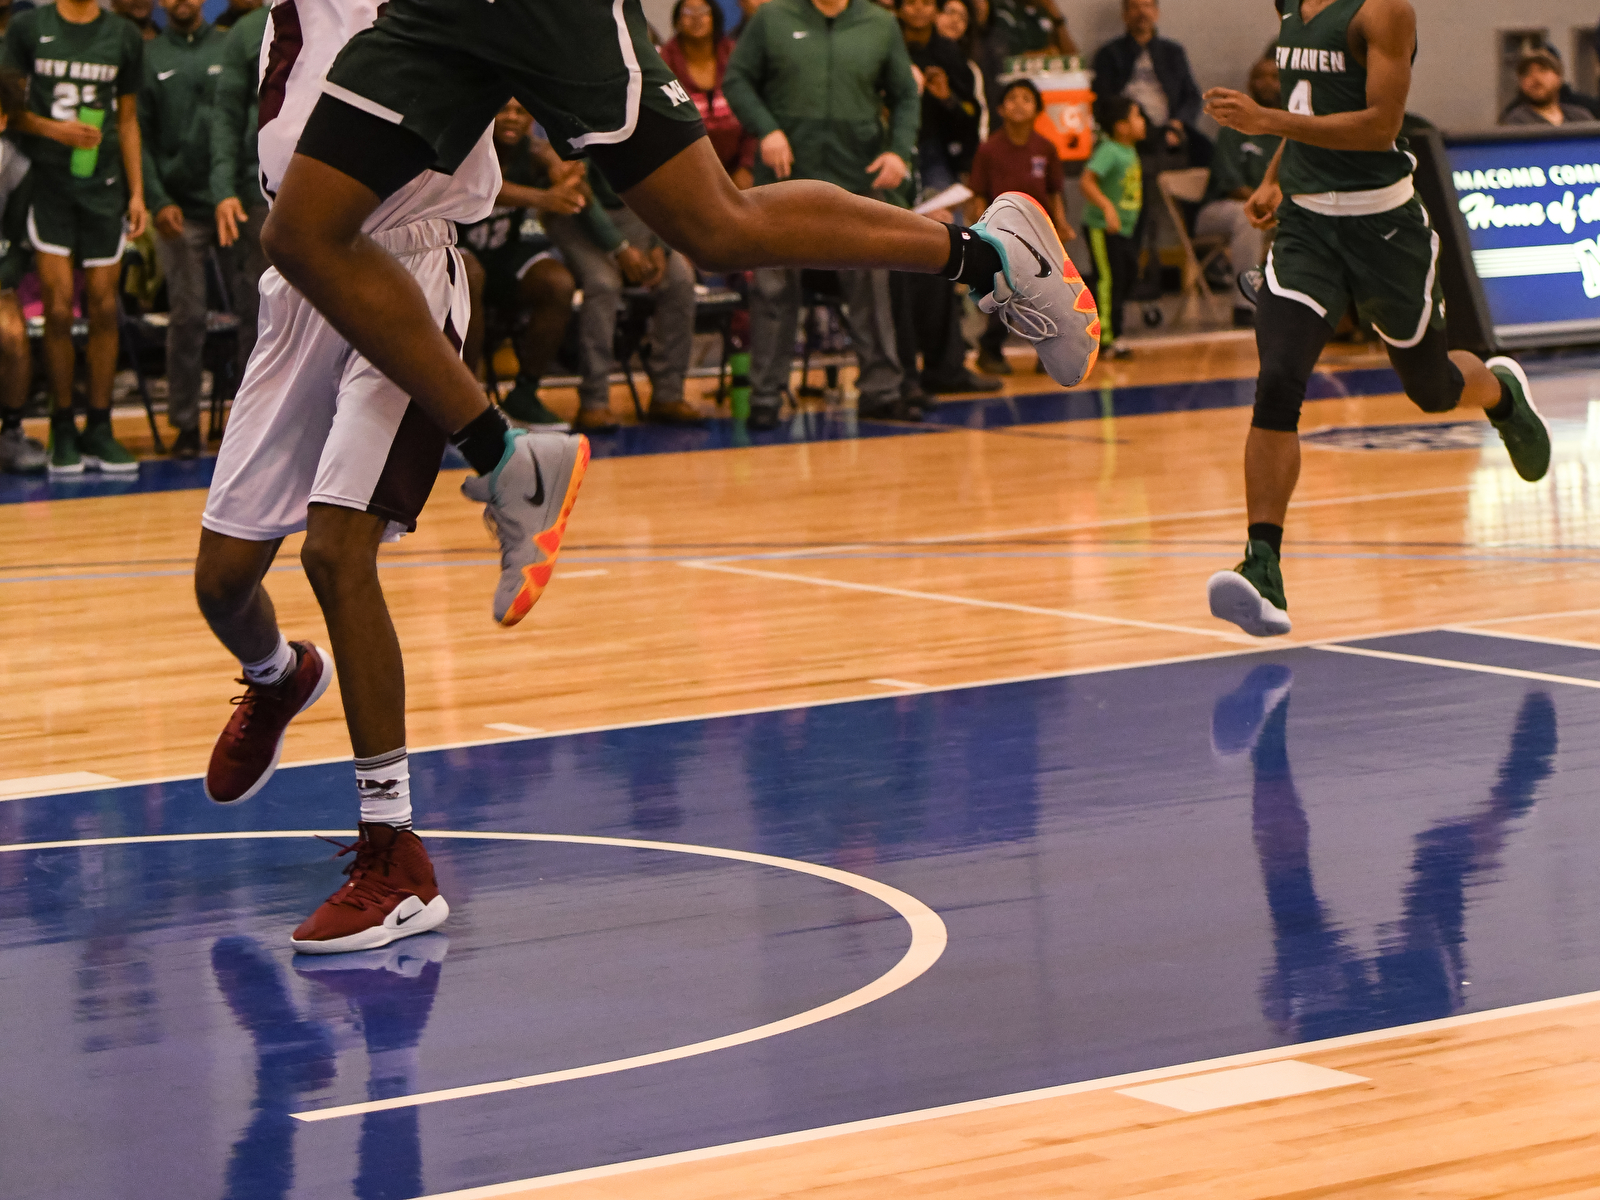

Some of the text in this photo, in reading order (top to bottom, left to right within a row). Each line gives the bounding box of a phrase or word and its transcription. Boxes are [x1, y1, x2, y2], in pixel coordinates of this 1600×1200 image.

[34, 58, 119, 83] NEW HAVEN
[1290, 47, 1347, 74] HAVEN
[1287, 79, 1316, 117] 4
[1452, 166, 1547, 191] MACOMB
[1458, 191, 1547, 231] Home
[1545, 190, 1578, 234] of
